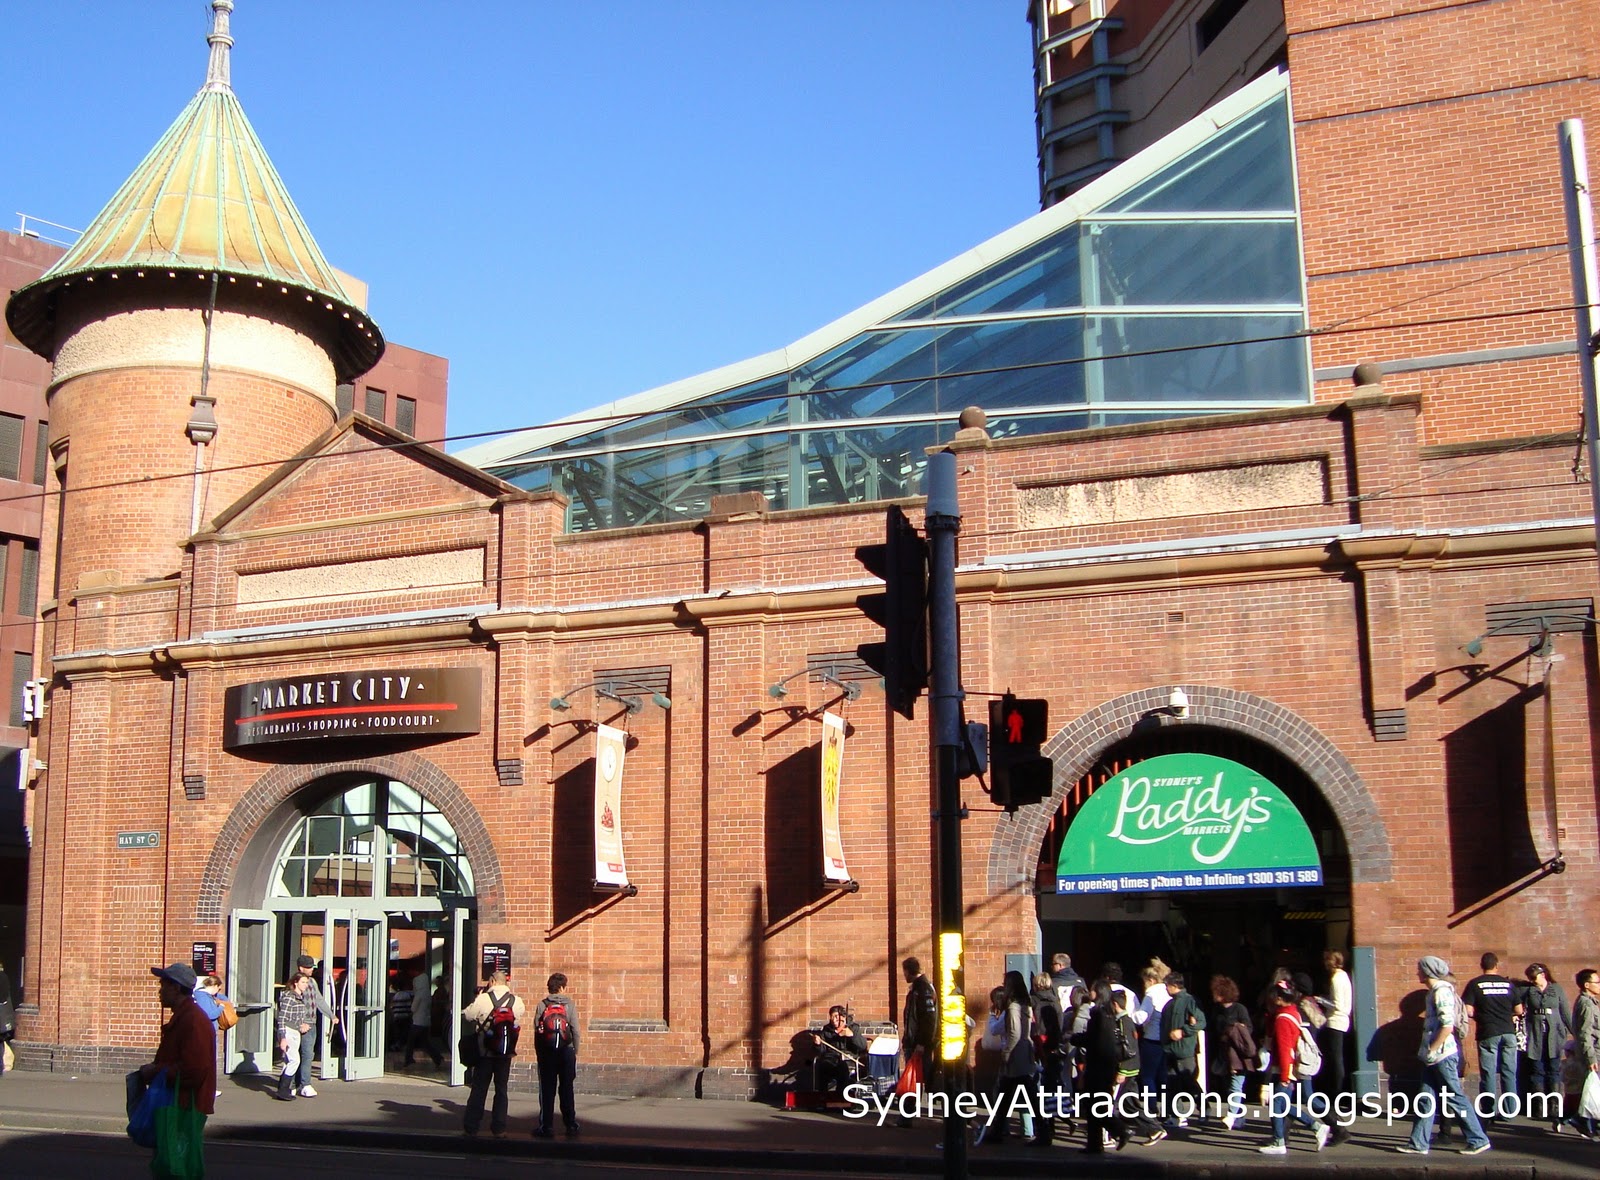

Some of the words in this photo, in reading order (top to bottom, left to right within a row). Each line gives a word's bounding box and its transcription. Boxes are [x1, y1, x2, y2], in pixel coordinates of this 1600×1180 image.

[260, 680, 341, 710] MARKET
[352, 676, 411, 701] CITY
[247, 722, 300, 737] RESTAURANTS
[308, 718, 357, 731] SHOPPING
[1152, 776, 1203, 788] SYDNEY'S
[1107, 771, 1273, 865] Paddy's
[1182, 824, 1233, 836] MARKETS
[119, 836, 133, 845] HAY
[136, 836, 146, 844] ST
[1058, 879, 1076, 891] For
[1078, 878, 1118, 892] opening
[1120, 877, 1149, 889] times
[1151, 876, 1183, 890] phone
[1184, 874, 1203, 887] the
[1204, 873, 1246, 886] Infoline
[1246, 872, 1274, 885] 1300
[1275, 871, 1295, 884] 361
[1297, 870, 1319, 883] 589
